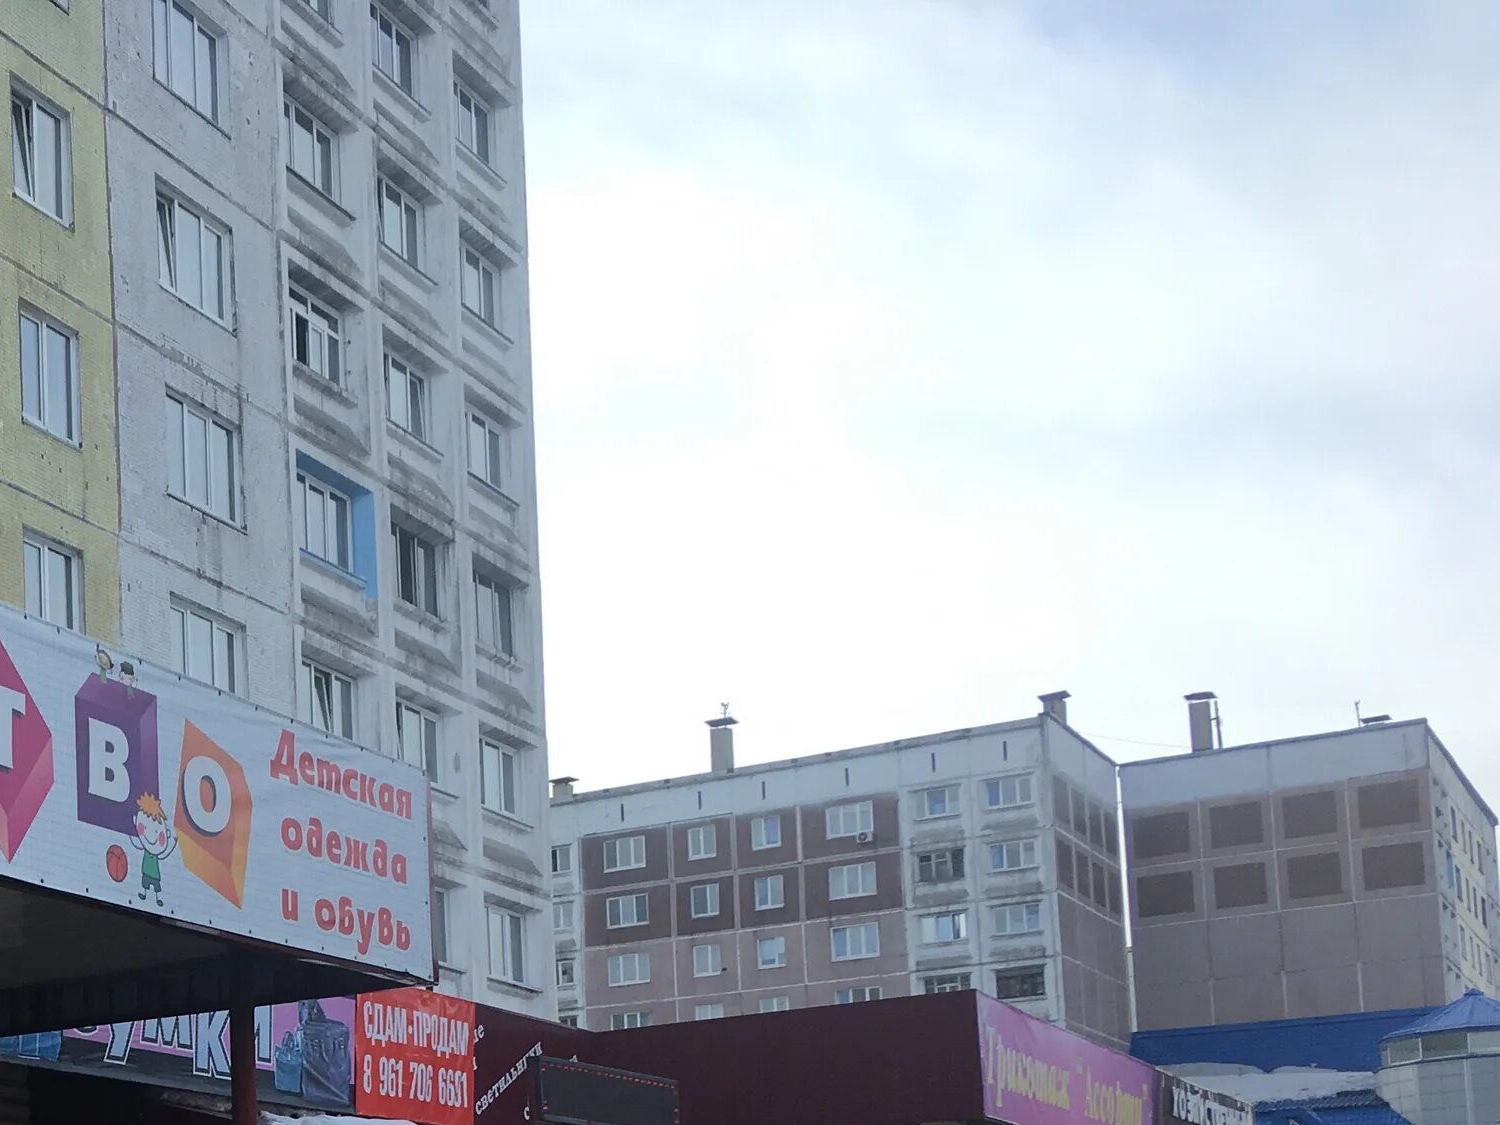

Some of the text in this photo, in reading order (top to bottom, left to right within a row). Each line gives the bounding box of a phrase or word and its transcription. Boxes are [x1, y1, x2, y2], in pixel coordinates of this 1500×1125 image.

[269, 729, 413, 819] Детская
[280, 813, 409, 885] одежда
[281, 887, 412, 956] и обувь
[362, 1053, 373, 1095] 8
[378, 1056, 405, 1099] 961
[408, 1061, 434, 1103] 706
